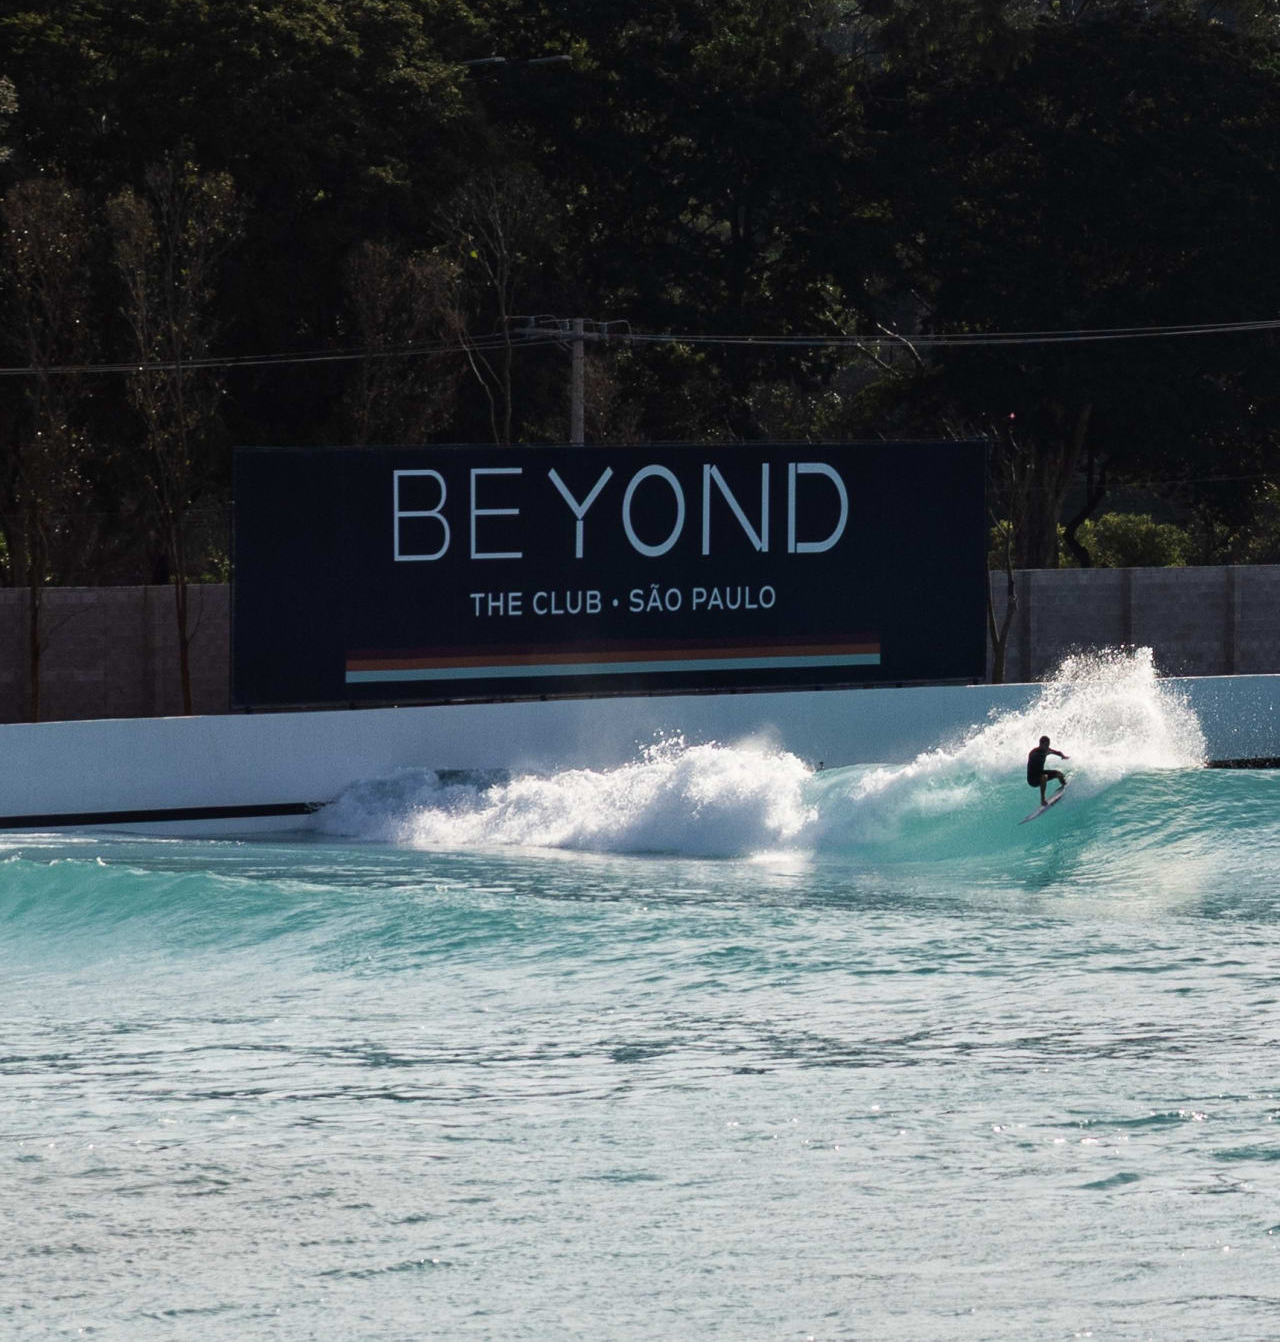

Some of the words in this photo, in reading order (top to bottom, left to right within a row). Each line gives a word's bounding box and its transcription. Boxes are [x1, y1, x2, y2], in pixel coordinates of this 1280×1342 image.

[393, 462, 849, 562] BEYOND
[469, 592, 523, 618] THE
[532, 590, 602, 615] CLUB
[629, 583, 682, 613] SÃO
[692, 585, 776, 612] PAULO
